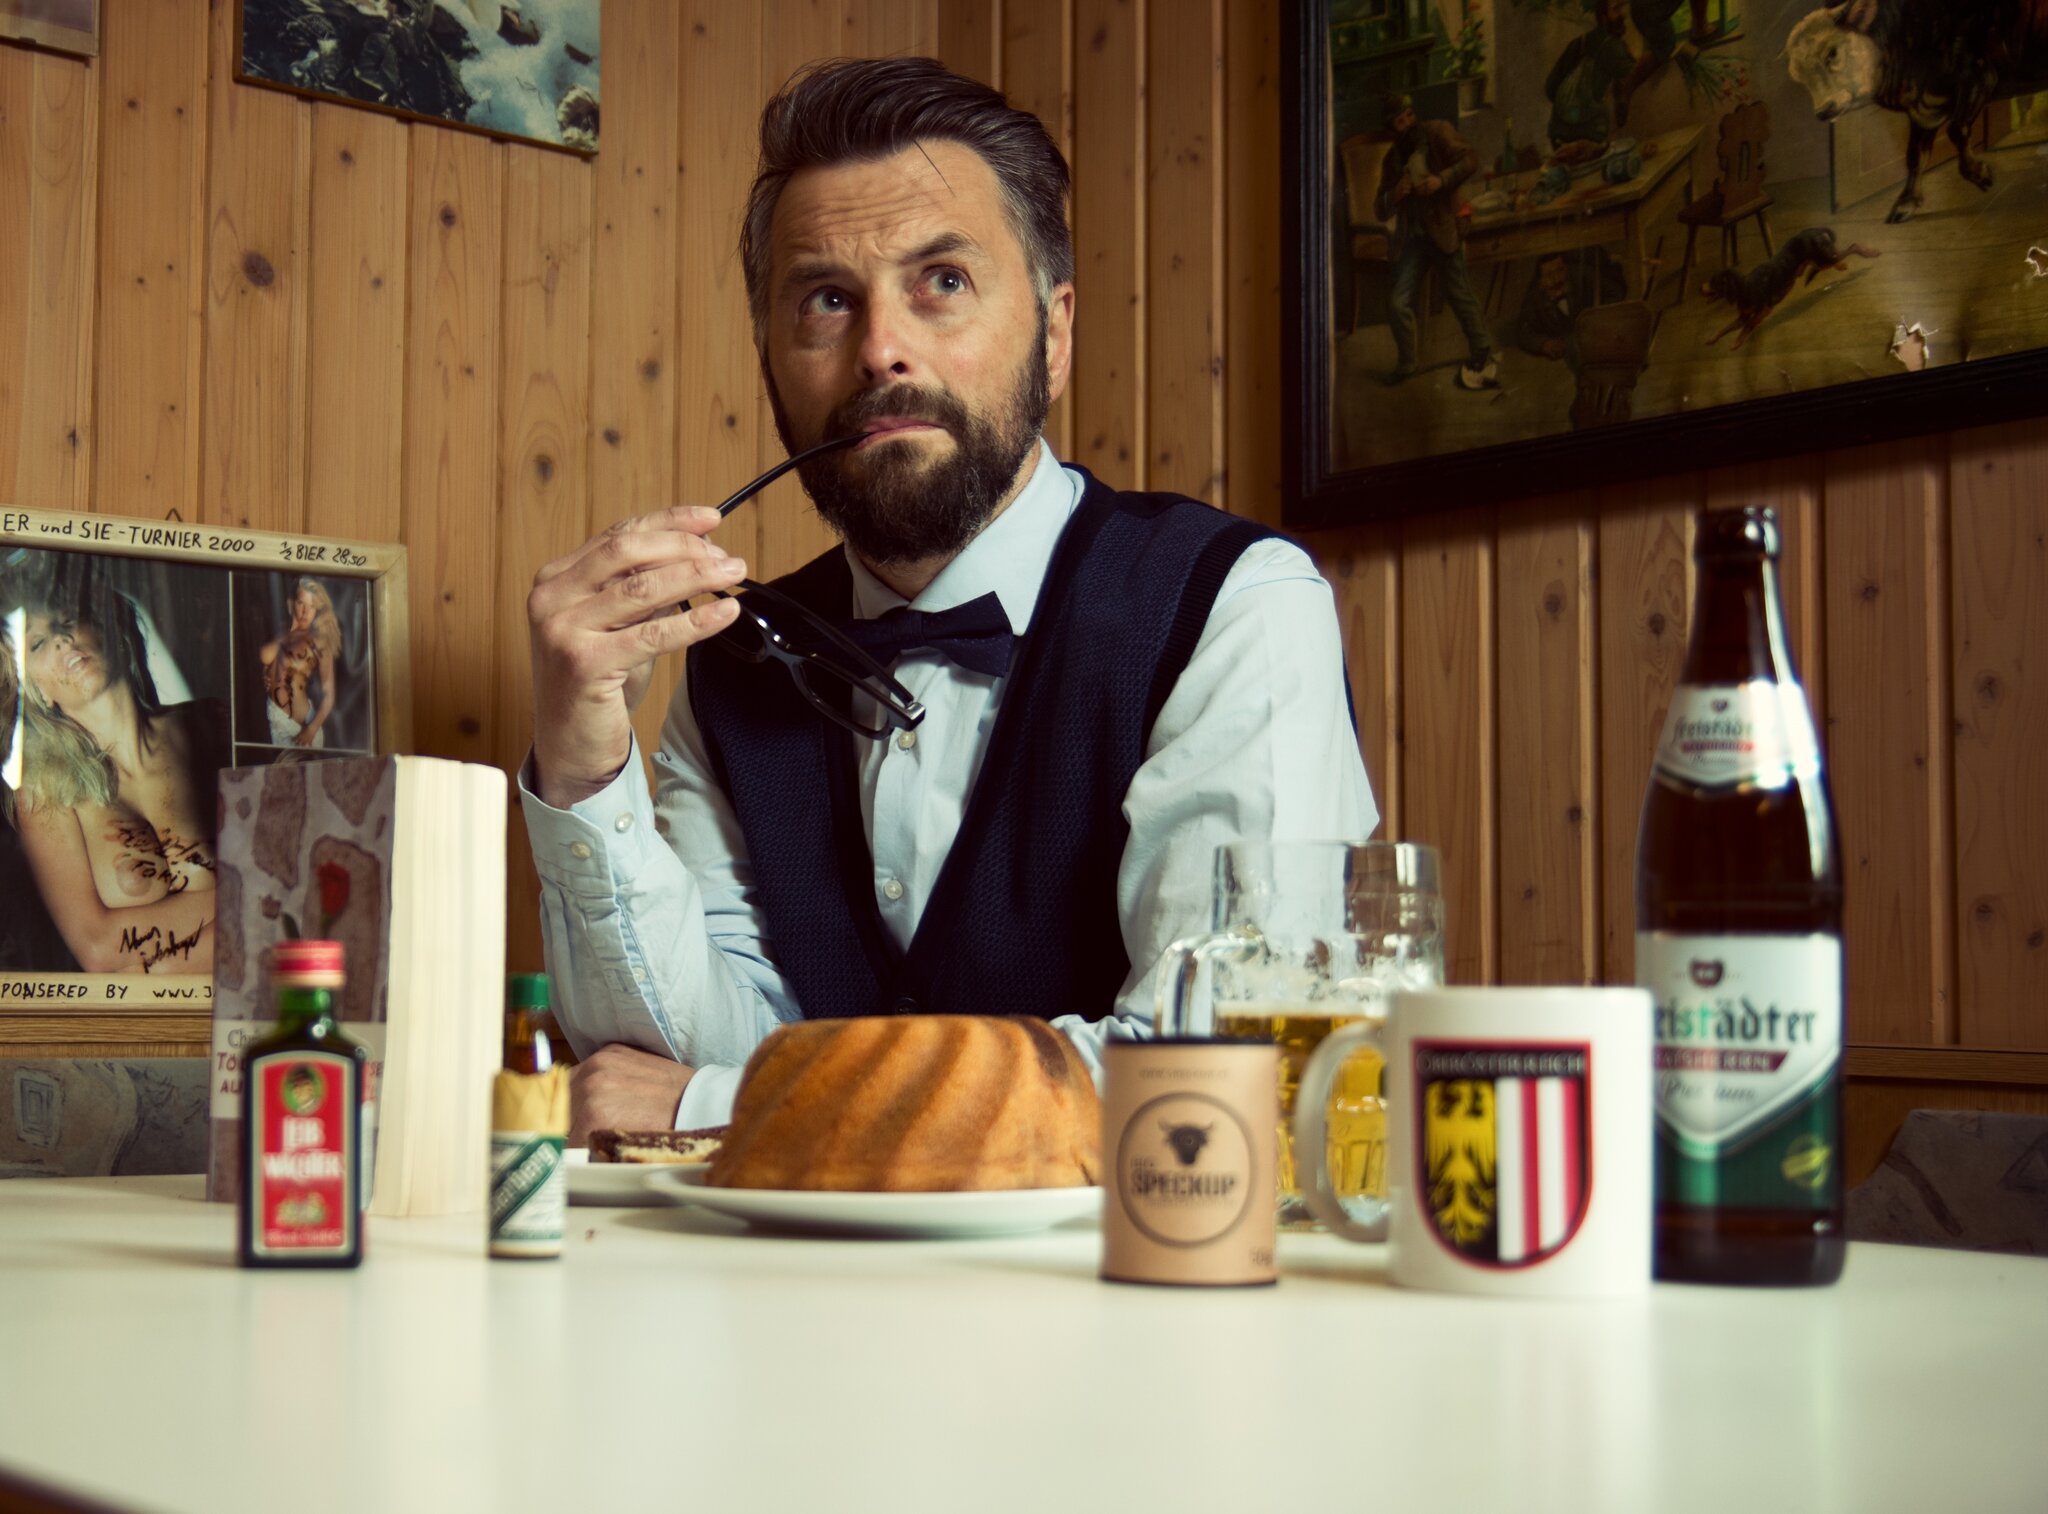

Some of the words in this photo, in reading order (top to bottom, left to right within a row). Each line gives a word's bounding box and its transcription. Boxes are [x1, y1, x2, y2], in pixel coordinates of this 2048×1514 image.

[3, 513, 30, 532] ER
[40, 520, 73, 535] und
[208, 536, 255, 552] 2000
[296, 543, 325, 561] BIER
[106, 984, 128, 999] BY
[1655, 998, 1817, 1043] eistädter
[1132, 1170, 1236, 1197] SPECKUP
